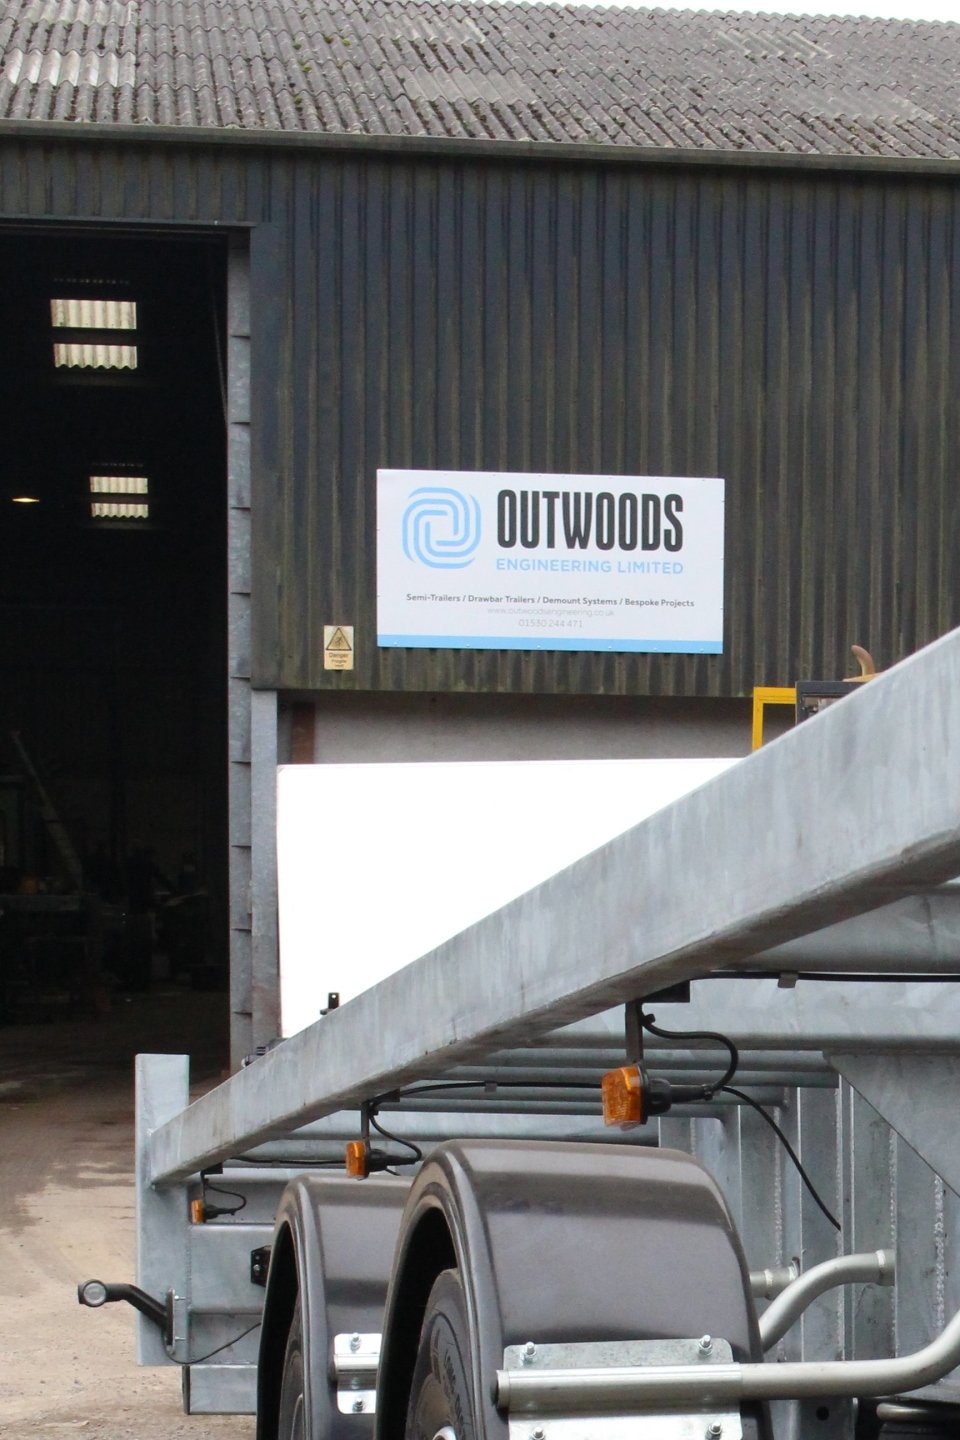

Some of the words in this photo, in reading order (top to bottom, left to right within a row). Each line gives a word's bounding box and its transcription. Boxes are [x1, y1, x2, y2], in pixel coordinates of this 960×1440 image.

[497, 489, 684, 552] OUTWOODS
[496, 558, 612, 573] ENGINEERING
[618, 562, 684, 574] LIMITED
[406, 593, 460, 602] Semi-Trailers
[505, 596, 535, 604] Trailers
[542, 596, 581, 605] Demount
[582, 597, 618, 606] Systems
[625, 598, 659, 607] Bespoke
[661, 599, 695, 608] Projects
